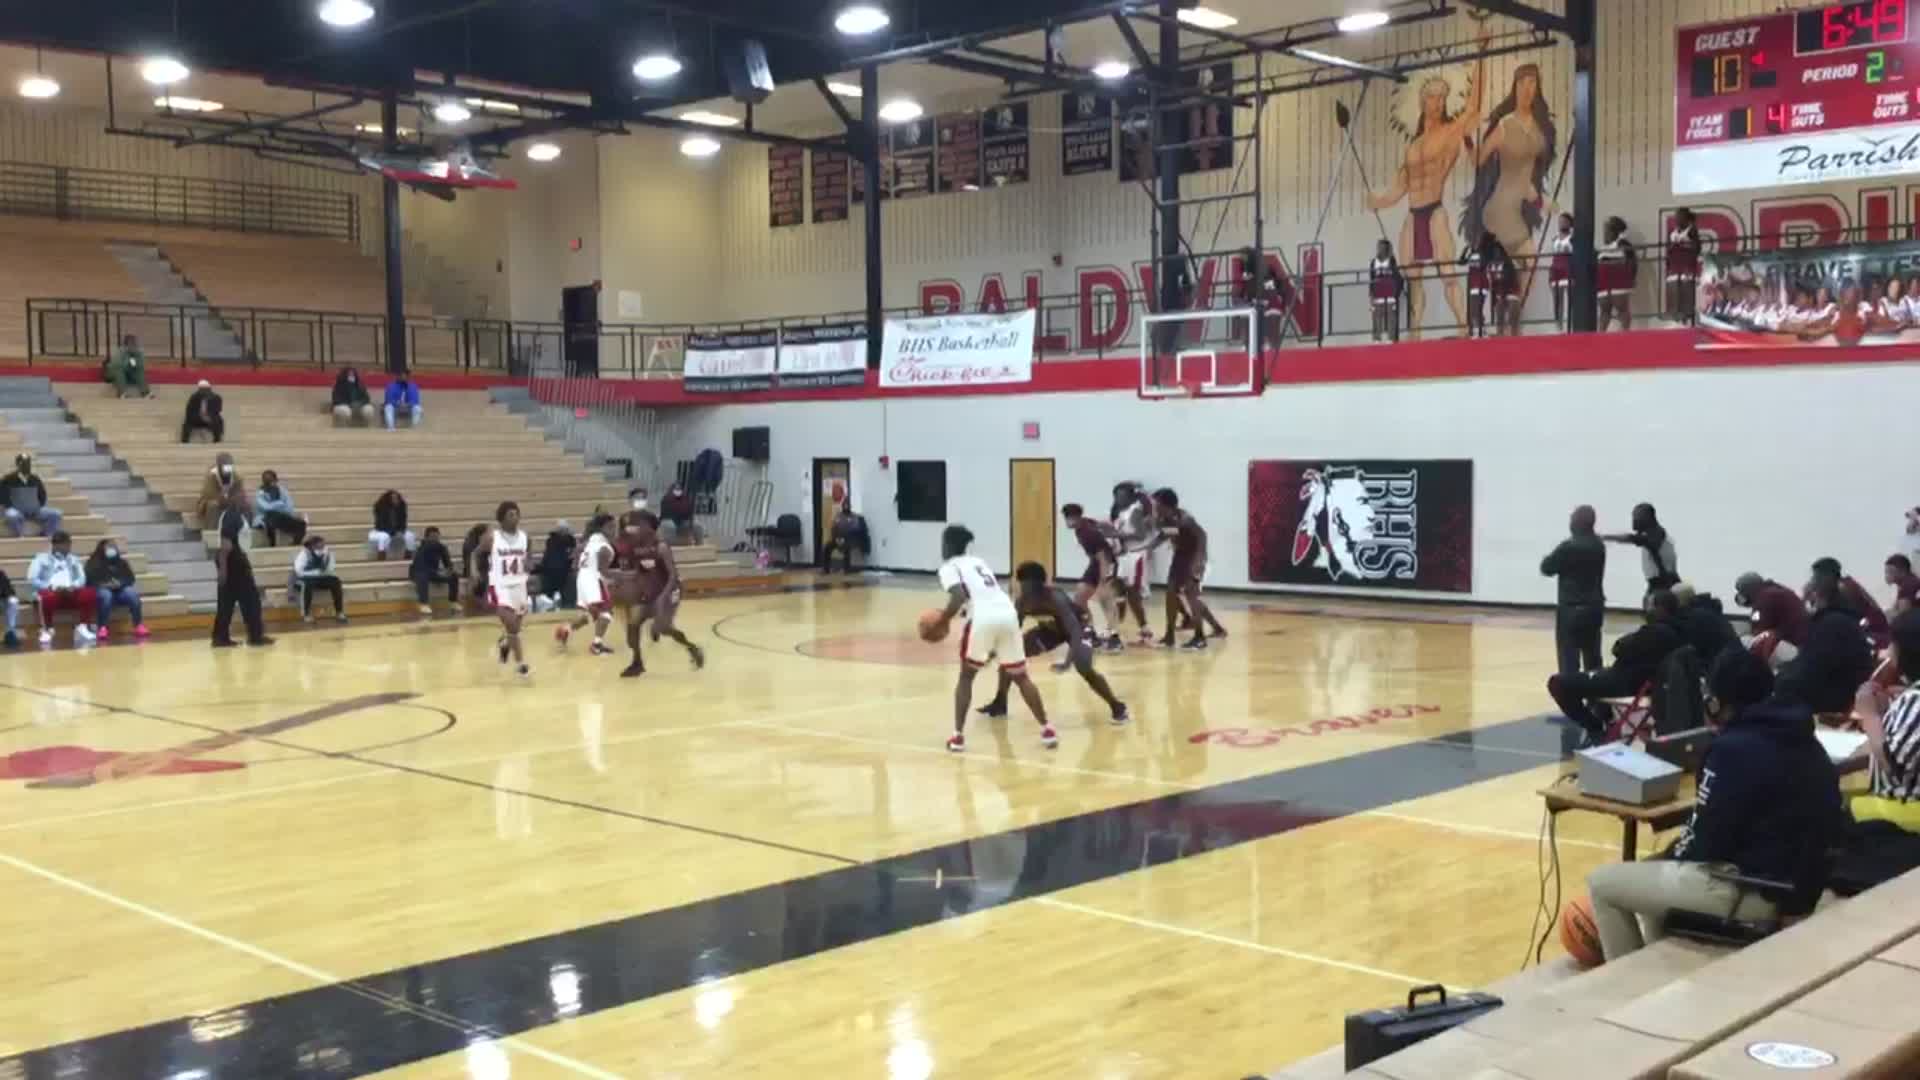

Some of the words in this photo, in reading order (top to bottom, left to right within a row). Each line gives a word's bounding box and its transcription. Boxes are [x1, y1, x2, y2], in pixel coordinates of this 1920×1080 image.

[1695, 26, 1760, 52] GUEST
[1714, 54, 1742, 94] 10
[1802, 63, 1858, 83] PERIOD
[1866, 51, 1885, 84] 2
[1876, 91, 1909, 105] TIME
[1768, 104, 1785, 131] 4
[1791, 102, 1823, 115] TIME
[1873, 103, 1908, 118] OUTS
[1689, 113, 1723, 128] TEAM
[1791, 113, 1824, 128] OUTS
[1686, 126, 1724, 140] FOULS
[1778, 132, 1920, 174] Parrish
[899, 336, 935, 353] BHS
[938, 331, 1020, 352] Basketball
[502, 557, 519, 575] 14
